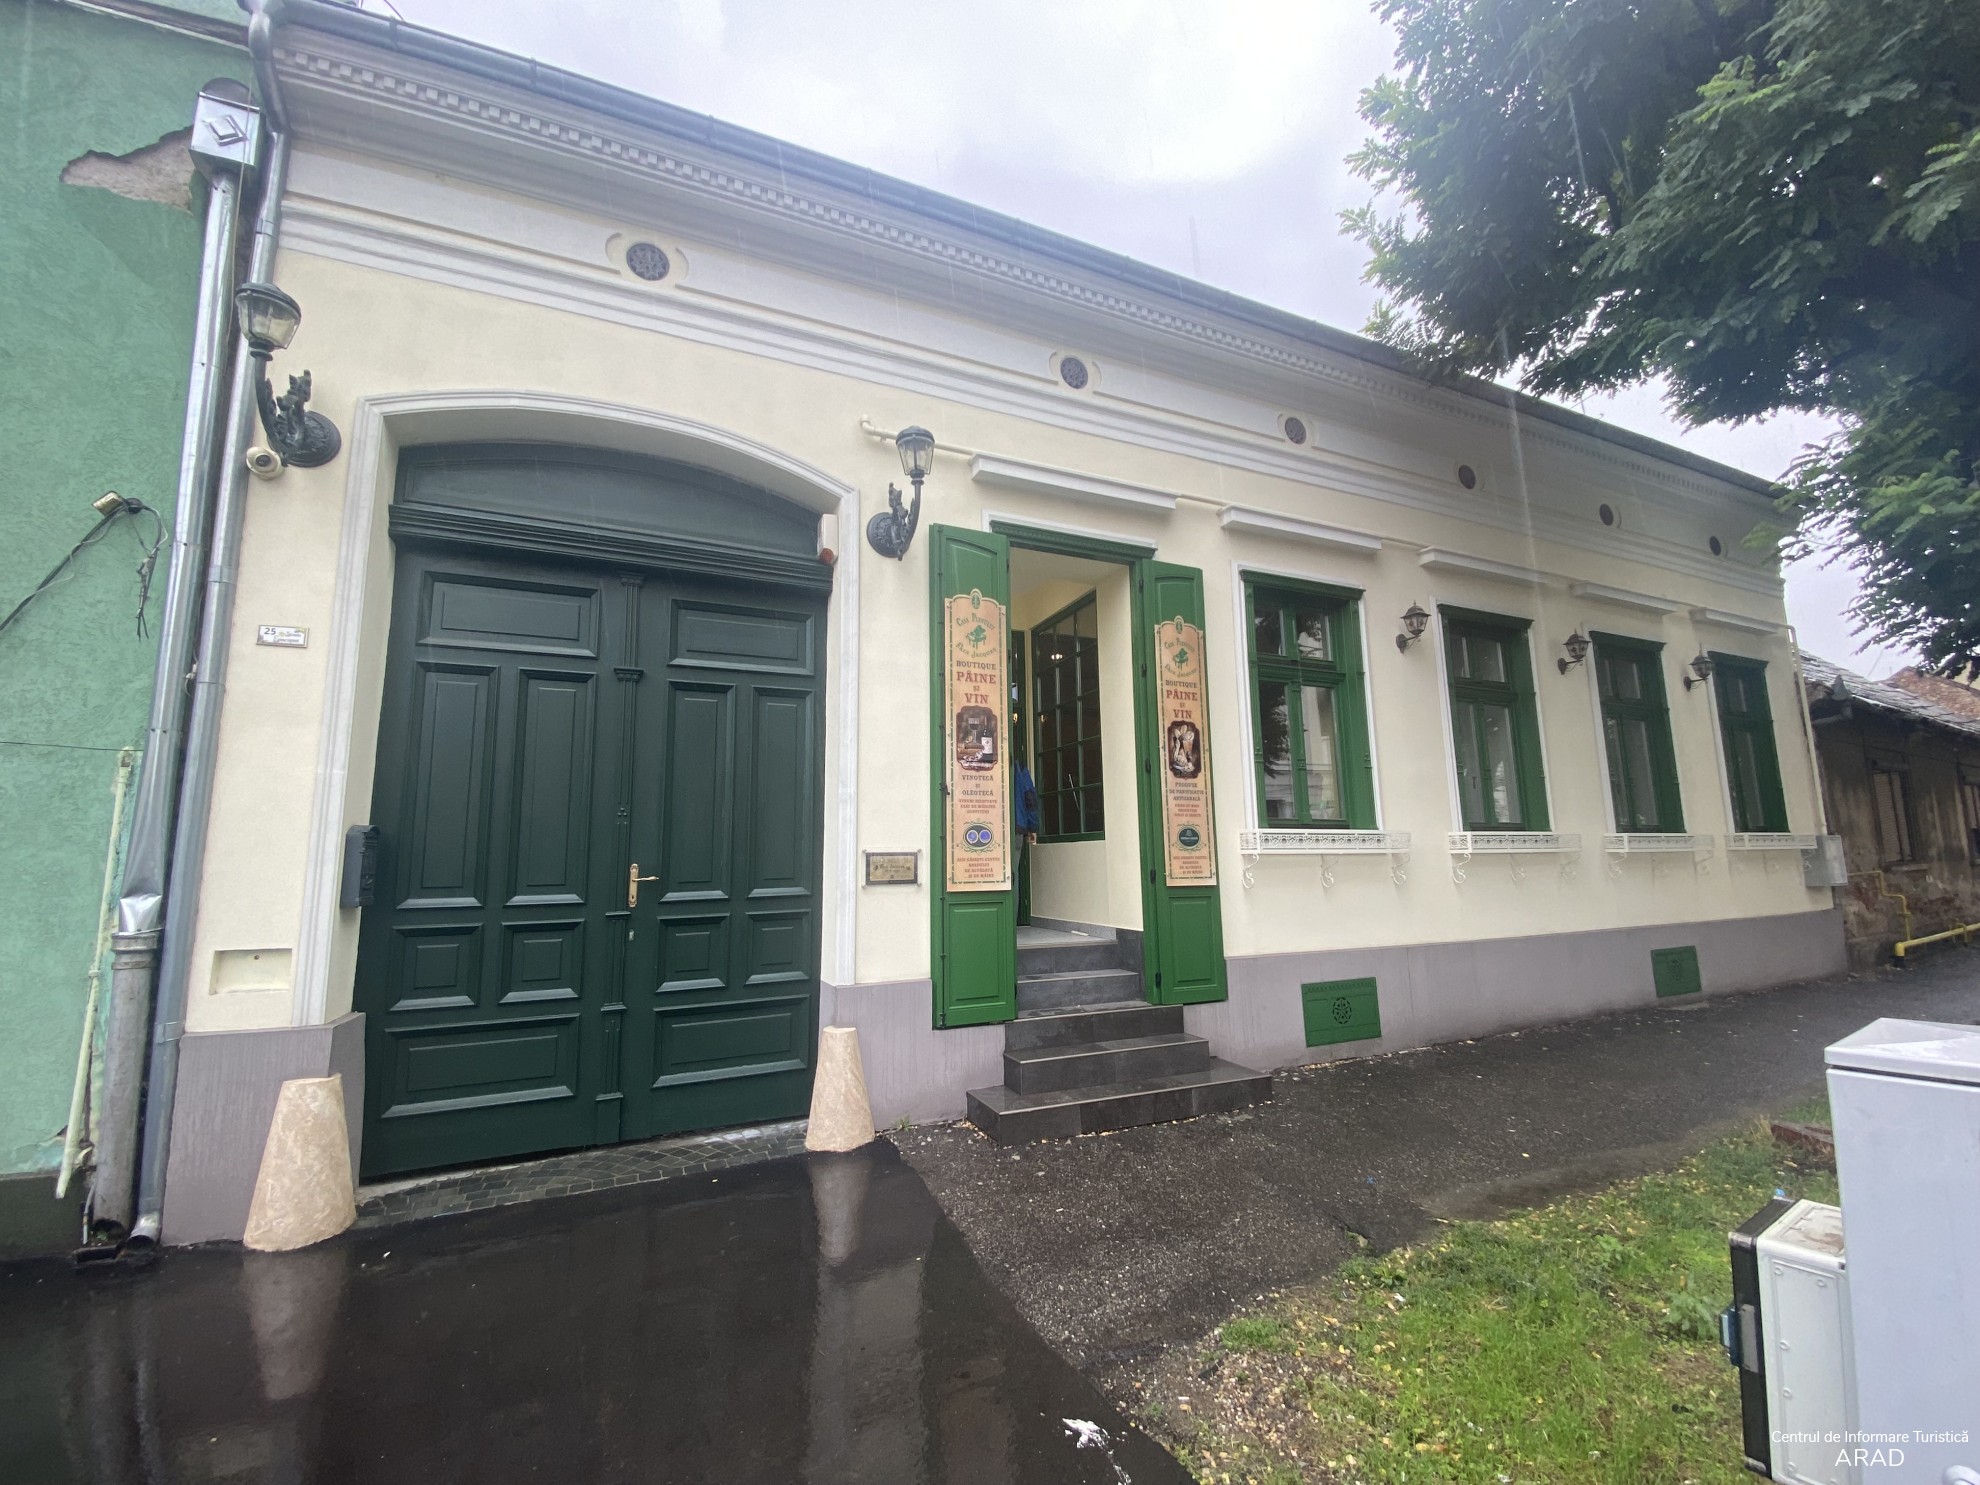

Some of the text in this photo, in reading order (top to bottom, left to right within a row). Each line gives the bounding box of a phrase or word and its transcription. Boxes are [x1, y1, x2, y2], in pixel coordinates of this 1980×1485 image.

[264, 627, 277, 636] 25
[956, 660, 997, 671] BOUTIQUE
[956, 670, 997, 685] PÂINE
[1165, 680, 1198, 689] BOUTIQUE
[964, 693, 989, 704] VIN
[1165, 689, 1198, 701] PÂINE
[1172, 709, 1192, 719] VIN
